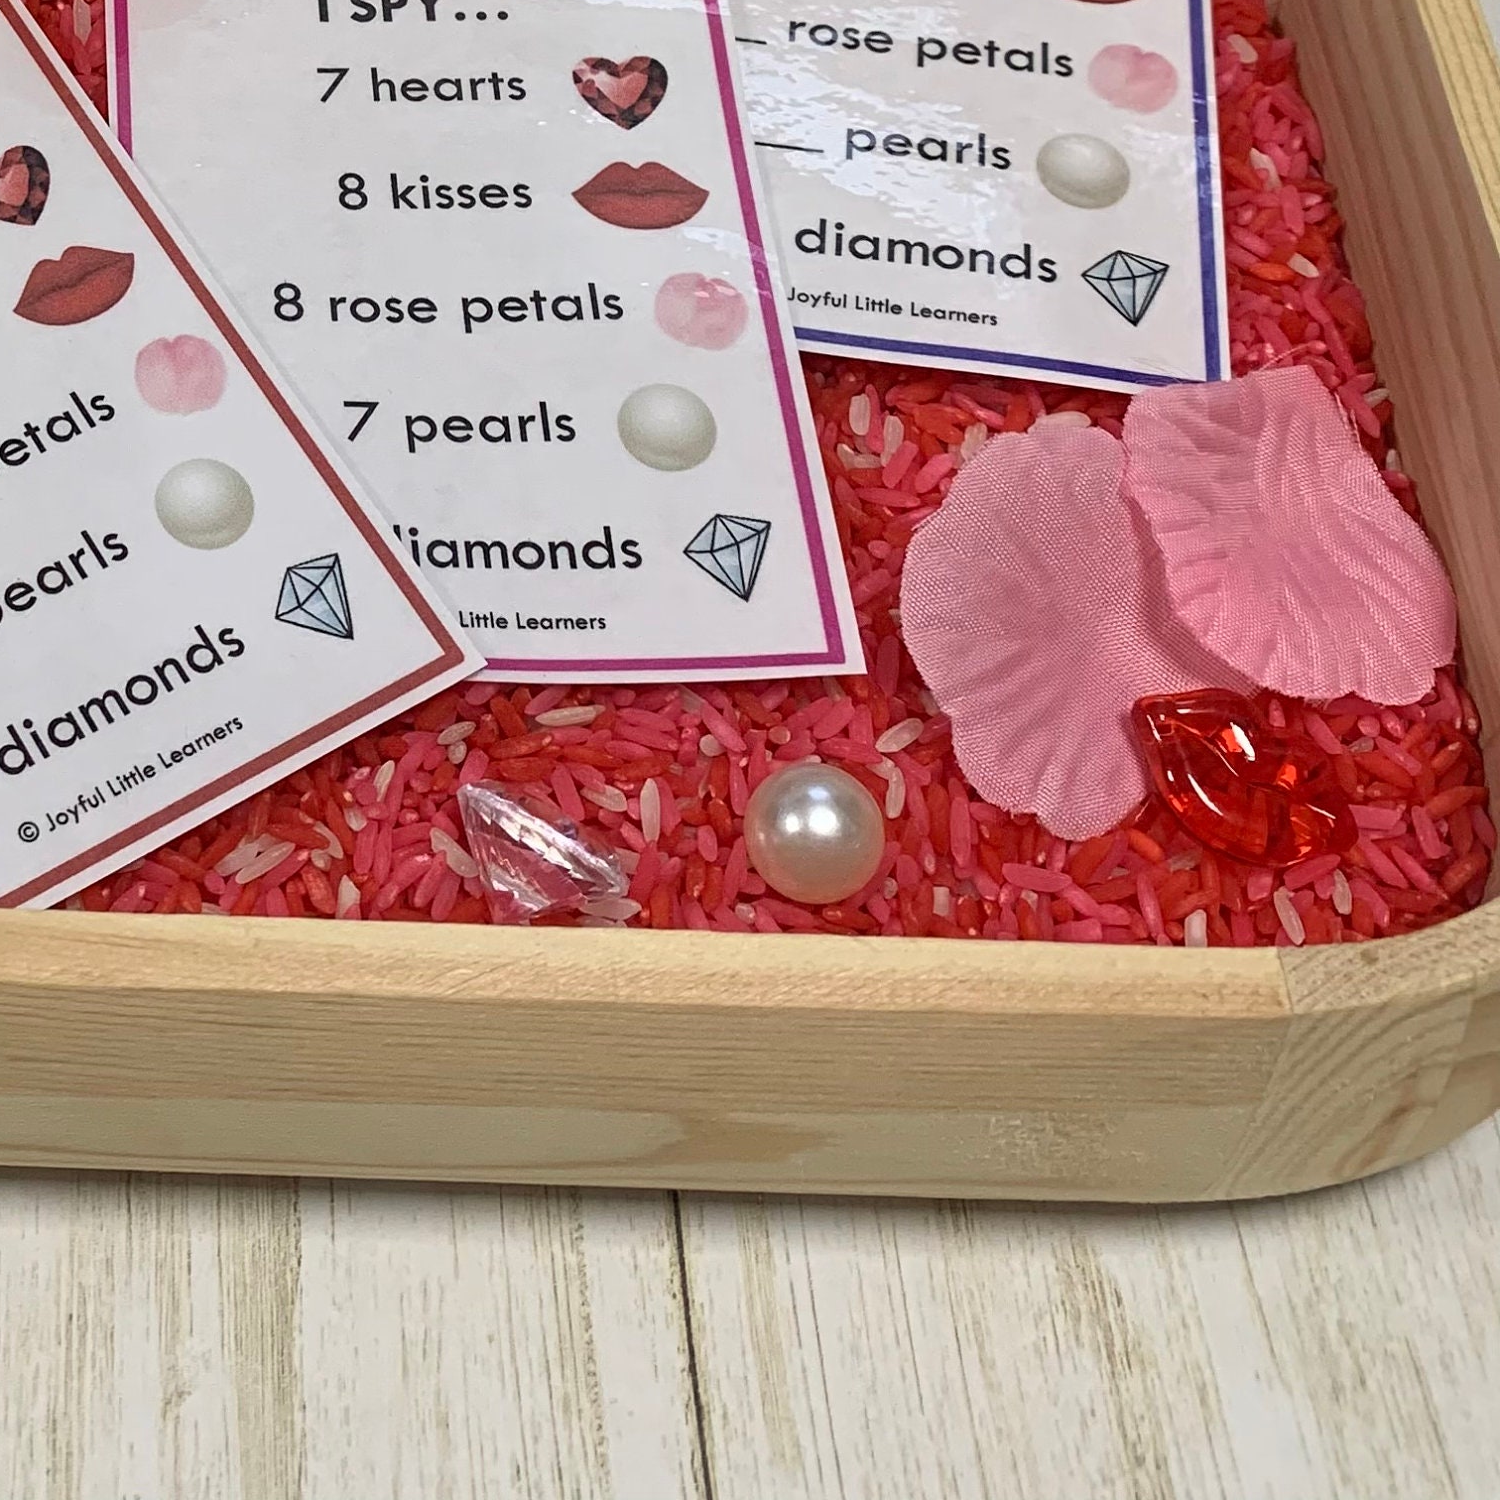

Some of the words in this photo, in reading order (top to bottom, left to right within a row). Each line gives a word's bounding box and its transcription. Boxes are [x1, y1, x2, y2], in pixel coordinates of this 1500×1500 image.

[788, 20, 893, 53] rose
[917, 37, 1073, 77] petals
[317, 68, 349, 103] 7
[371, 67, 526, 102] hearts
[846, 128, 1012, 170] pearls
[338, 173, 368, 210] 8
[390, 173, 532, 209] kisses
[795, 218, 1057, 283] diamonds
[274, 281, 304, 322] 8
[329, 296, 438, 324] rose
[461, 282, 623, 334] petals
[787, 287, 847, 308] Joyful
[855, 295, 903, 315] Little
[911, 302, 997, 326] Learners
[343, 401, 379, 442] 7
[405, 401, 576, 453] pearls
[393, 524, 642, 570] iamonds
[458, 610, 508, 629] Little
[516, 612, 606, 630] Learners
[46, 786, 106, 832] Joyful
[106, 765, 156, 797] Little
[157, 717, 243, 769] Learners
